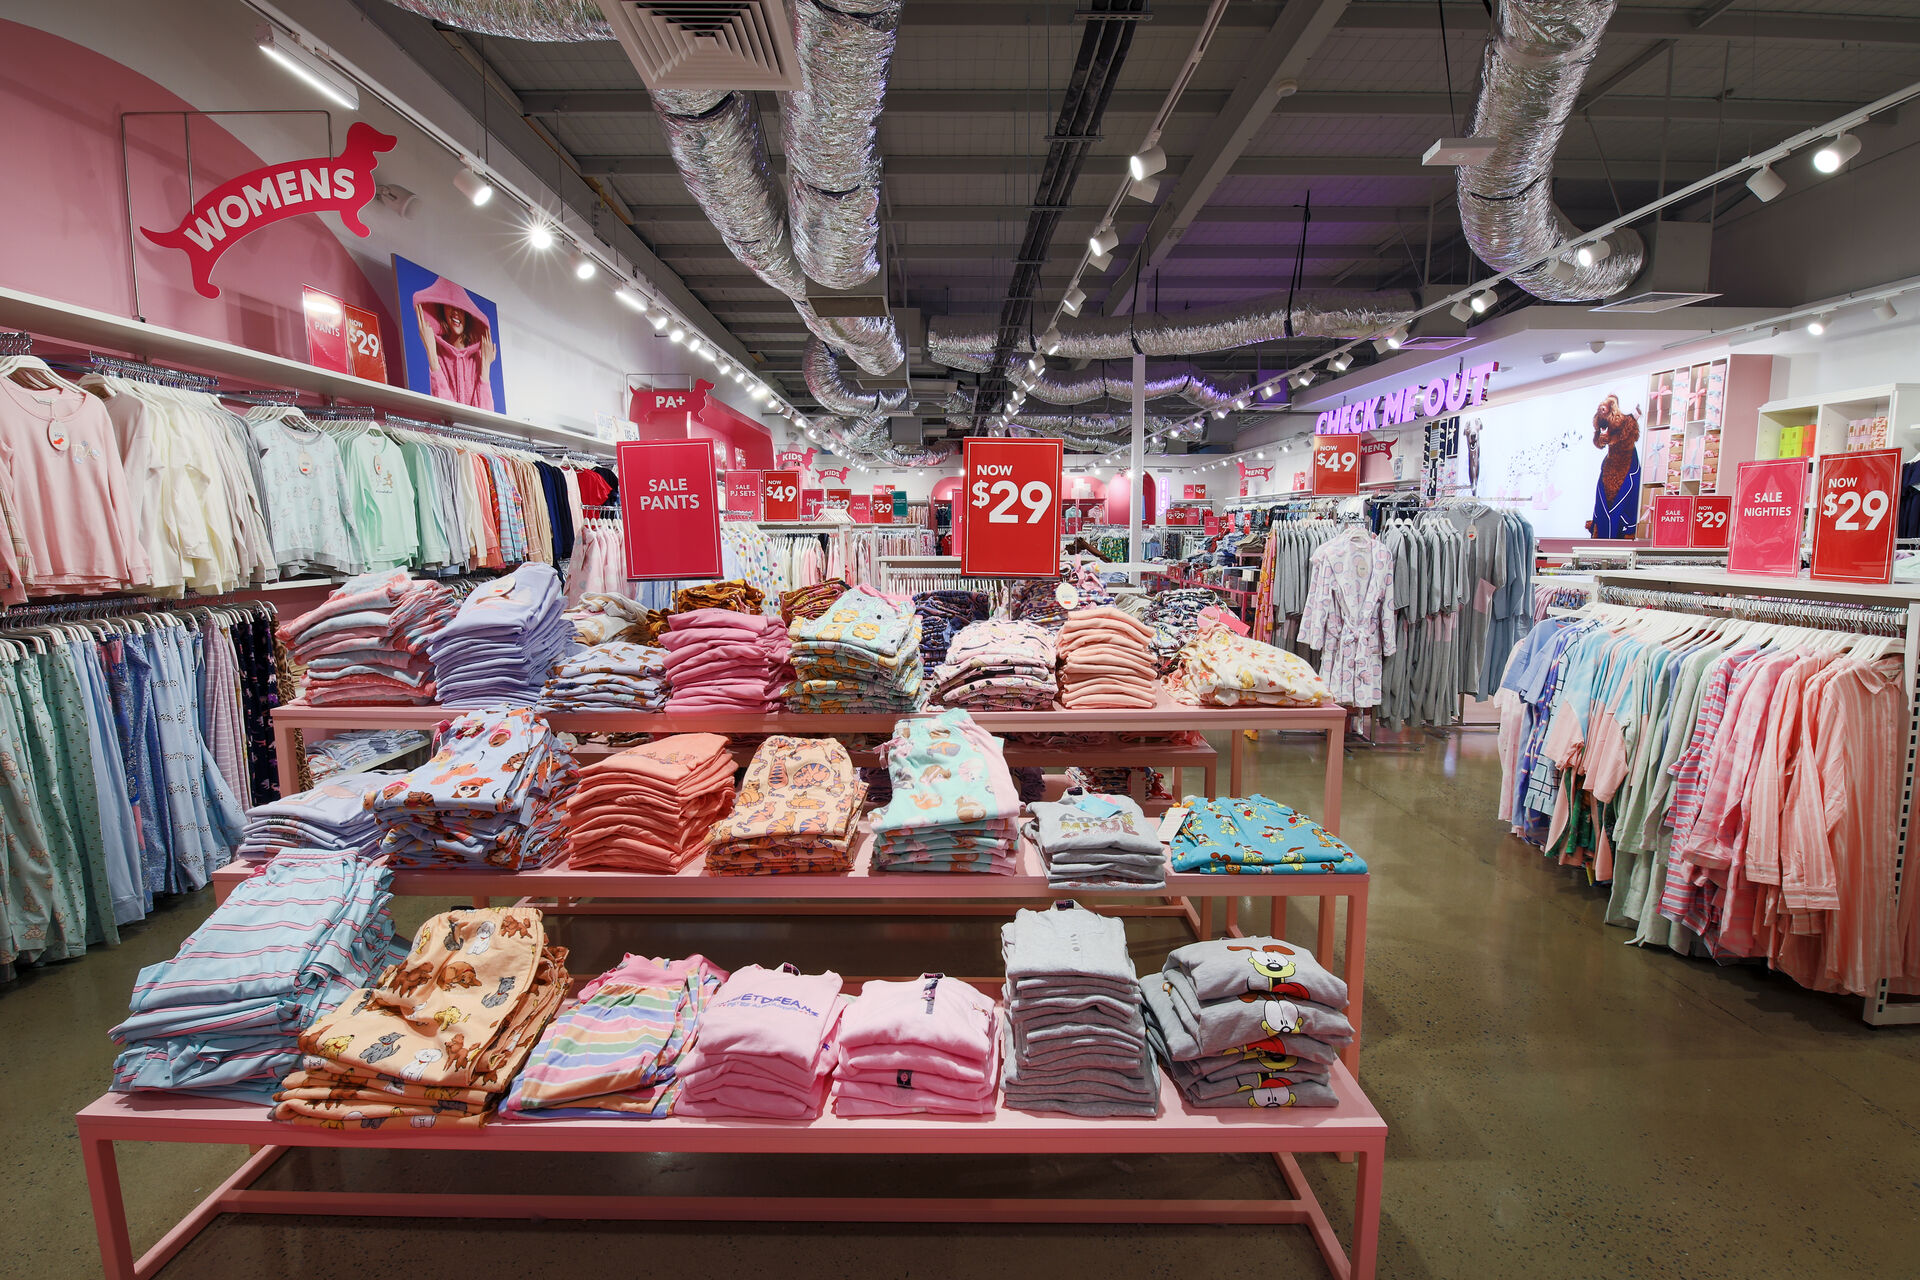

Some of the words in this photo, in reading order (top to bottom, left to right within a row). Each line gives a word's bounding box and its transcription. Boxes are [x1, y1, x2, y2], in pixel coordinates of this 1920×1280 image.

[183, 167, 355, 252] WOMENS
[314, 321, 341, 337] PANTS
[349, 318, 363, 328] NOW
[349, 327, 380, 358] $29
[655, 395, 686, 408] PA+
[1315, 396, 1381, 434] CHECK
[1382, 384, 1419, 428] ME
[1423, 361, 1498, 417] OUT
[782, 452, 803, 462] KIDS
[1317, 452, 1357, 472] $49
[976, 464, 1013, 476] NOW
[648, 478, 688, 492] SALE
[1828, 477, 1858, 489] NOW
[766, 485, 797, 502] $49
[1754, 492, 1783, 503] SALE
[640, 494, 700, 511] PANTS
[874, 503, 892, 513] $29
[971, 479, 1053, 524] $29
[1744, 506, 1792, 517] NIGHTIES
[1822, 490, 1889, 531] $29
[1660, 515, 1685, 523] PANTS
[1696, 511, 1727, 528] $29
